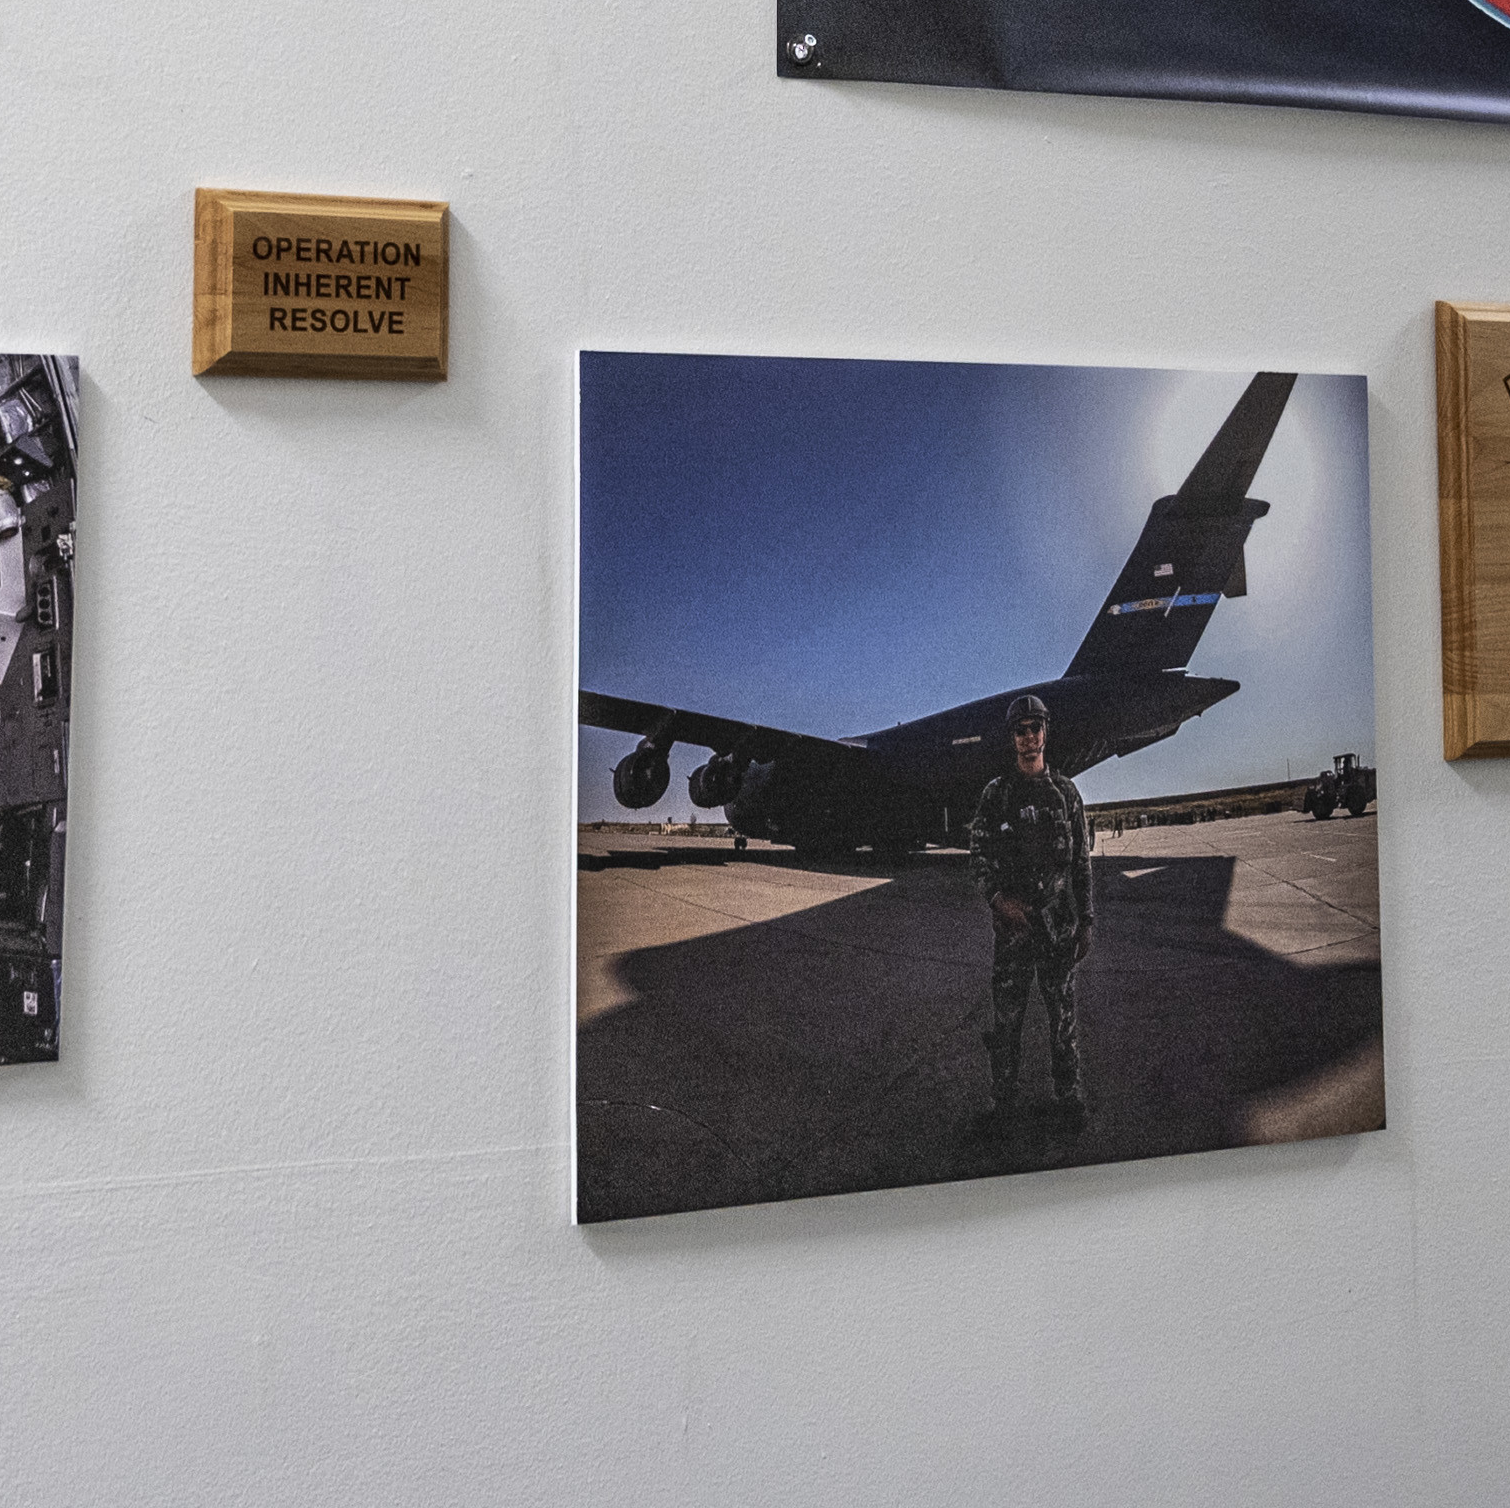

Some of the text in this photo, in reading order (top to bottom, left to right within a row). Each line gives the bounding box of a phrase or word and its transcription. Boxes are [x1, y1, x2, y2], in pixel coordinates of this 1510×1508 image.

[252, 236, 421, 267] OPERATION
[263, 272, 411, 301] INHERENT
[269, 307, 405, 335] RESOLVE
